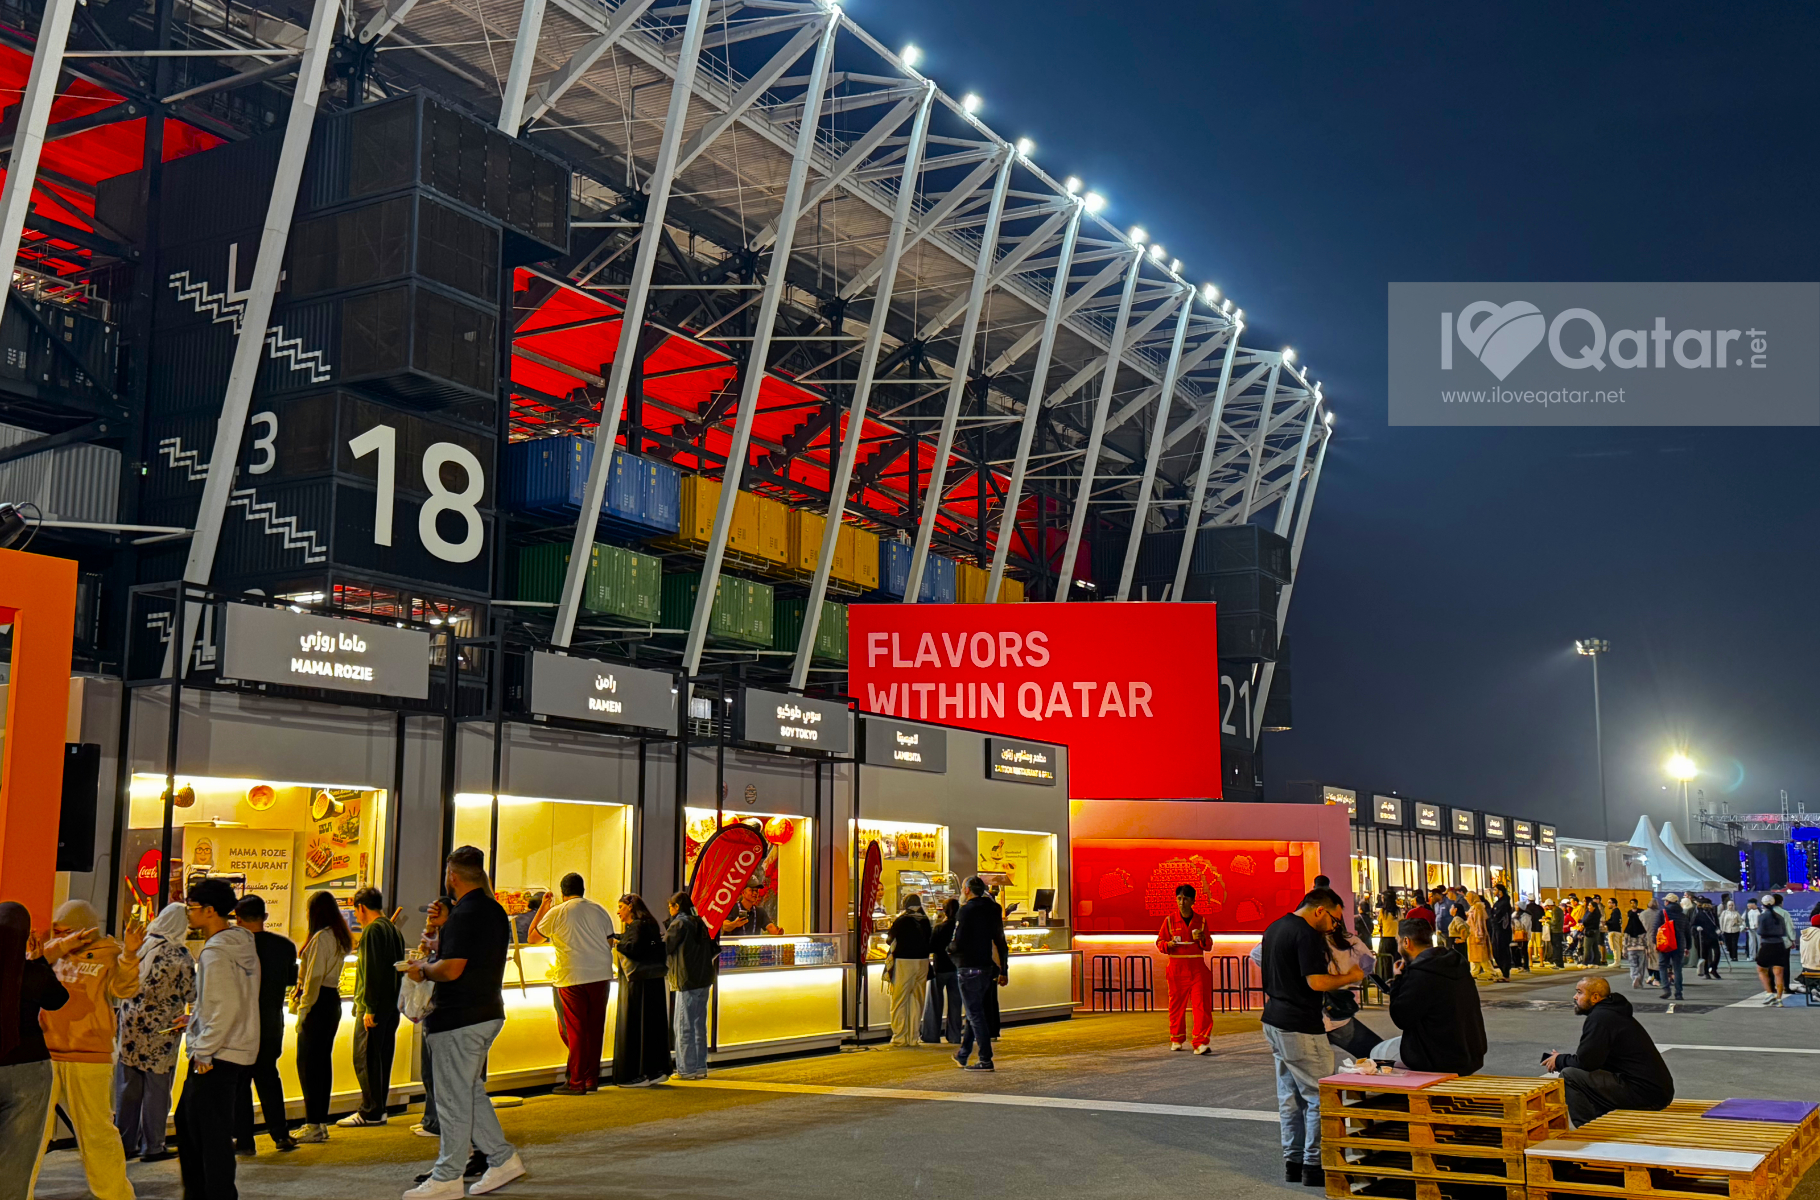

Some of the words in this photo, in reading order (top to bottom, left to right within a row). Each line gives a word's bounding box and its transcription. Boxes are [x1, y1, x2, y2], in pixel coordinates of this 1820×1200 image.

[348, 424, 485, 563] 18
[300, 631, 335, 653] روزي
[339, 632, 367, 653] ماما
[867, 630, 1050, 668] FLAVORS
[291, 657, 333, 677] MAMA
[334, 663, 373, 681] ROZIE
[595, 674, 617, 693] رامن
[588, 697, 622, 714] RAMEN
[867, 682, 1005, 719] WITHIN
[1017, 681, 1154, 722] QATAR
[1220, 675, 1251, 739] 21
[780, 725, 795, 738] SOY
[795, 728, 818, 741] TOKYO
[229, 848, 258, 857] MAMA
[261, 849, 287, 857] ROZIE
[230, 861, 289, 870] RESTAURANT
[270, 882, 289, 891] Food
[707, 850, 756, 914] TOKYO
